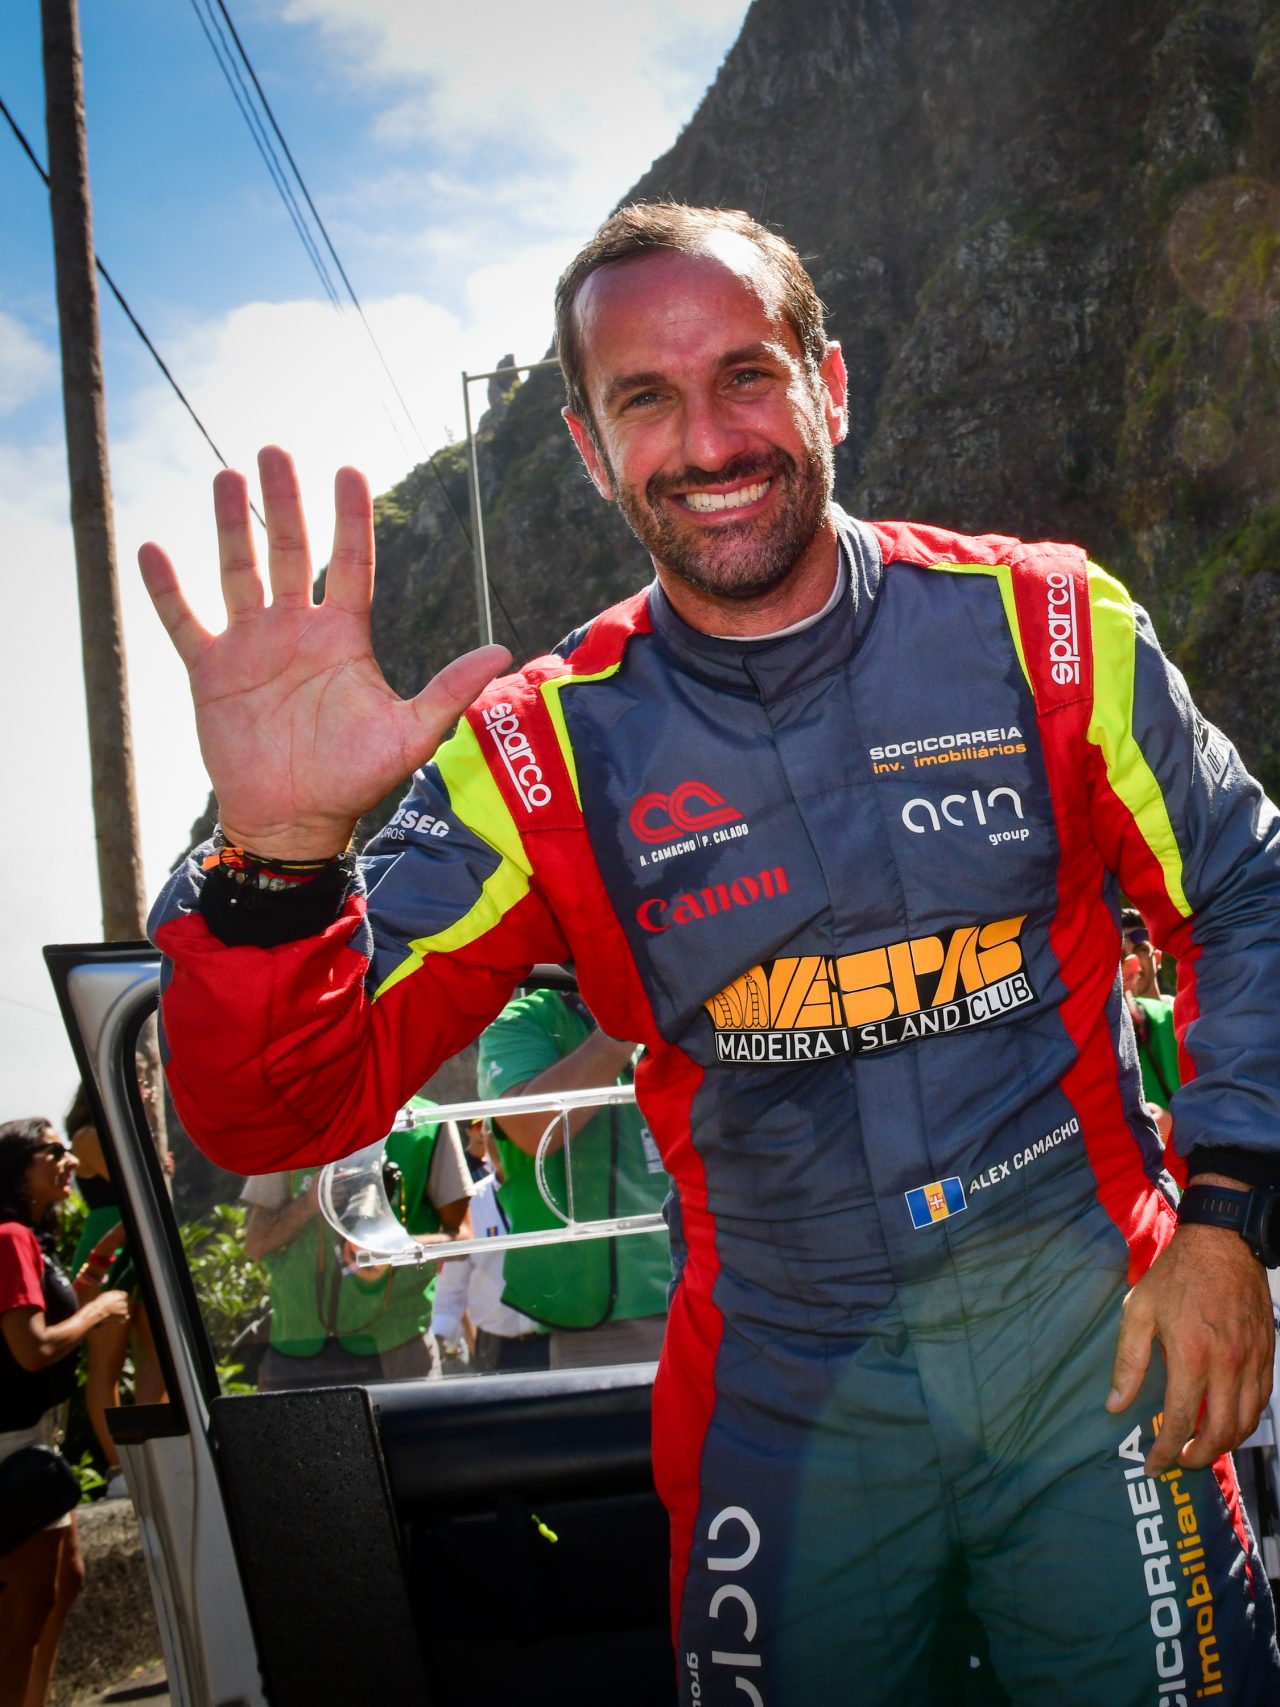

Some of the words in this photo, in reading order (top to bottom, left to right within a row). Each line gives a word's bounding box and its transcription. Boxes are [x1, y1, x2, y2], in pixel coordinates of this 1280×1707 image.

[1046, 572, 1080, 685] sparco
[483, 702, 552, 813] sparco
[869, 726, 1023, 760] SOCICORREIA
[873, 762, 905, 775] inv.
[914, 743, 1027, 768] imobiliários
[902, 787, 1024, 833] acin
[988, 828, 1030, 845] group
[639, 854, 650, 867] A.
[651, 839, 697, 863] CAMACHO
[702, 835, 713, 847] P.
[713, 823, 749, 844] CALADO
[636, 866, 789, 933] Canon
[742, 914, 1028, 1029] VESPAS
[718, 1032, 834, 1060] MADEIRA
[842, 1004, 961, 1052] ISLAND
[970, 975, 1030, 1020] CLUB
[970, 1160, 1010, 1194] ALEX
[1013, 1117, 1080, 1170] CAMACHO
[686, 1652, 701, 1707] gro
